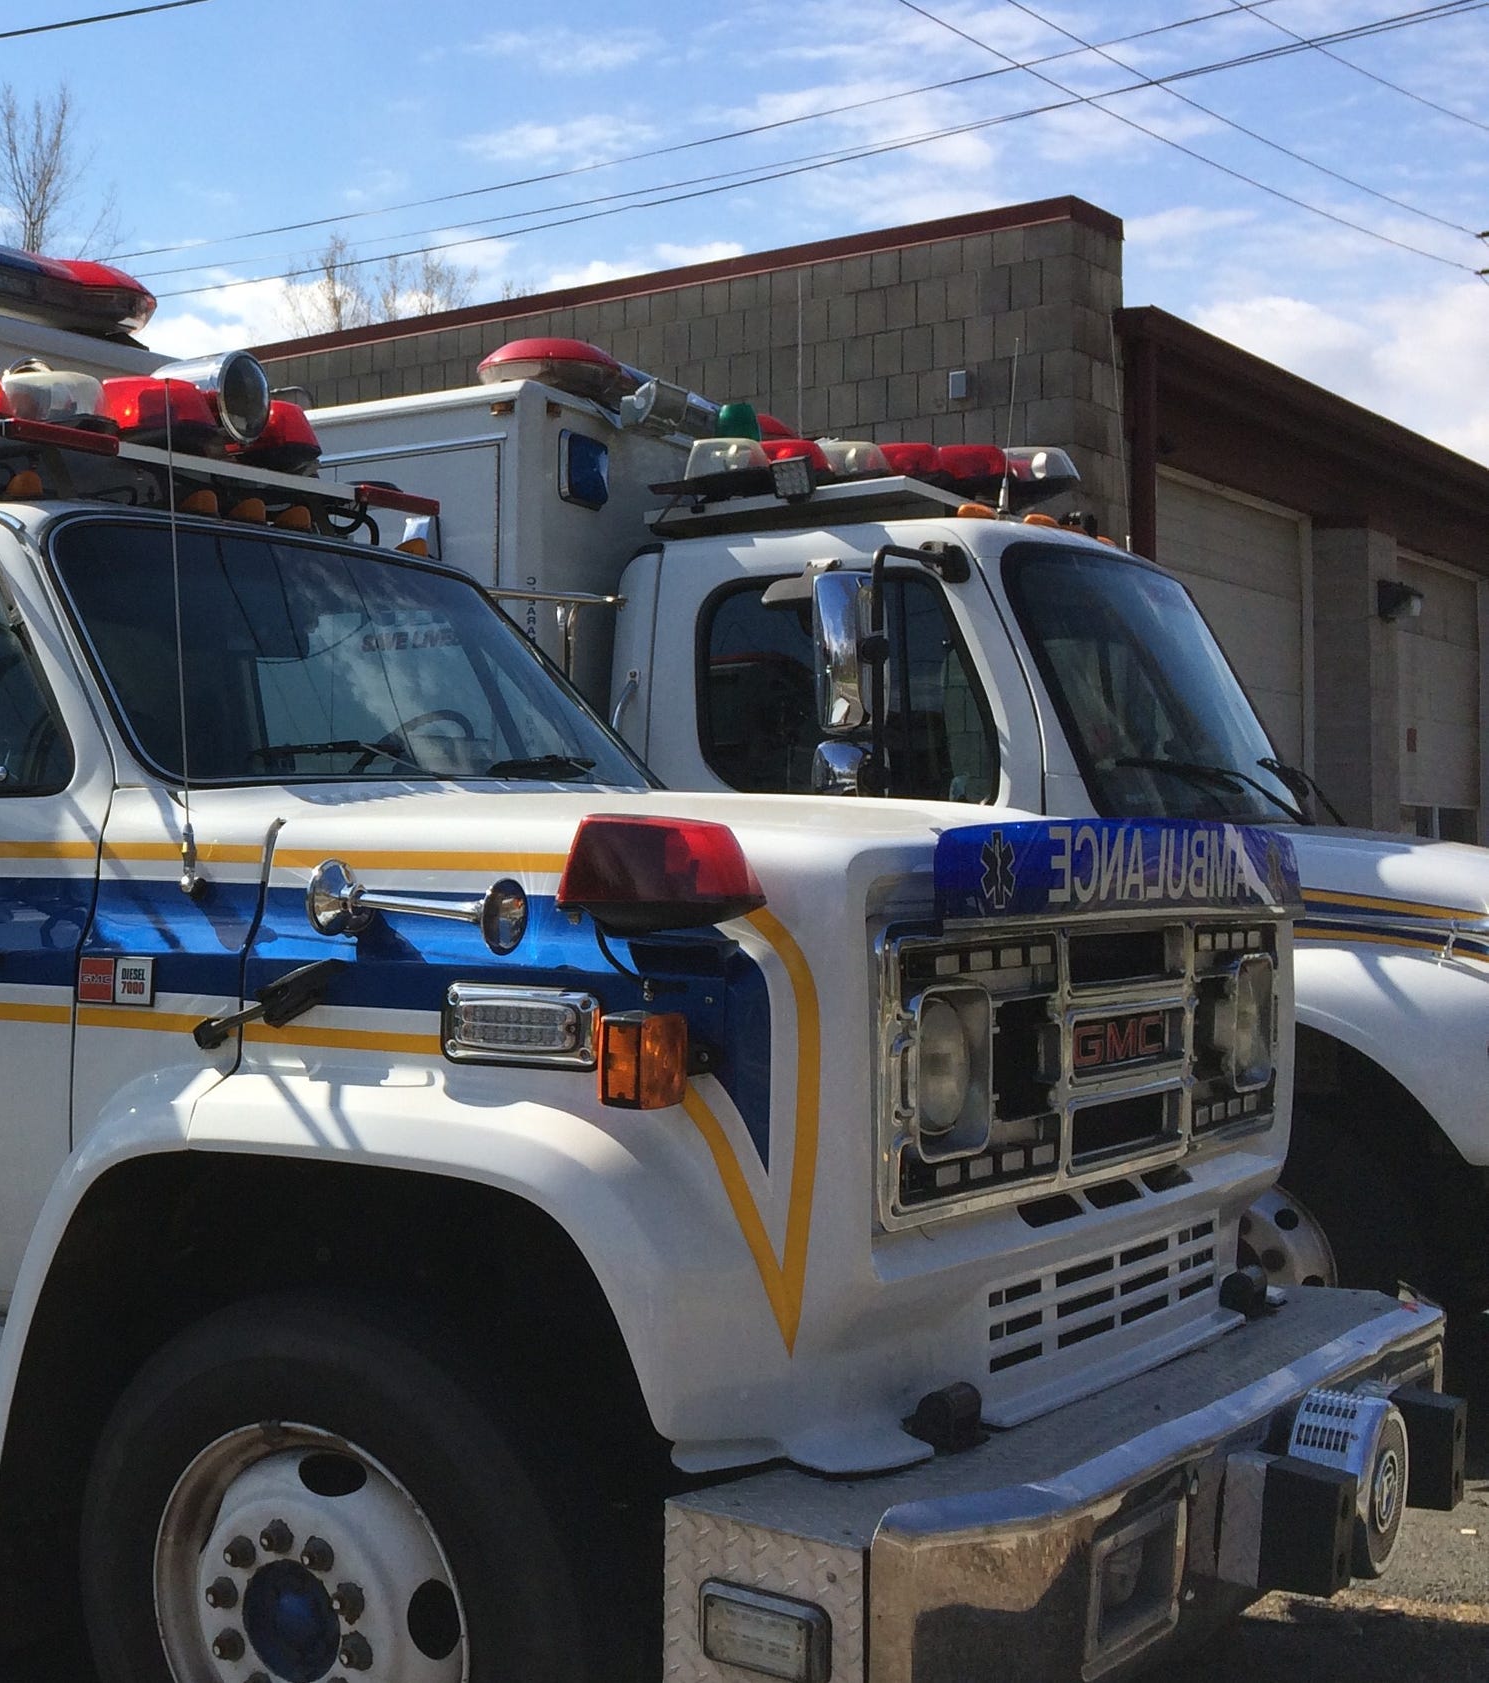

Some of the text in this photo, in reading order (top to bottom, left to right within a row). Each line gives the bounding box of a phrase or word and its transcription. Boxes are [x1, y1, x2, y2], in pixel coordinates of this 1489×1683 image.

[80, 973, 112, 985] GMC
[121, 967, 145, 981] DIESEL
[121, 981, 144, 995] 7000
[1073, 1015, 1163, 1066] GMC
